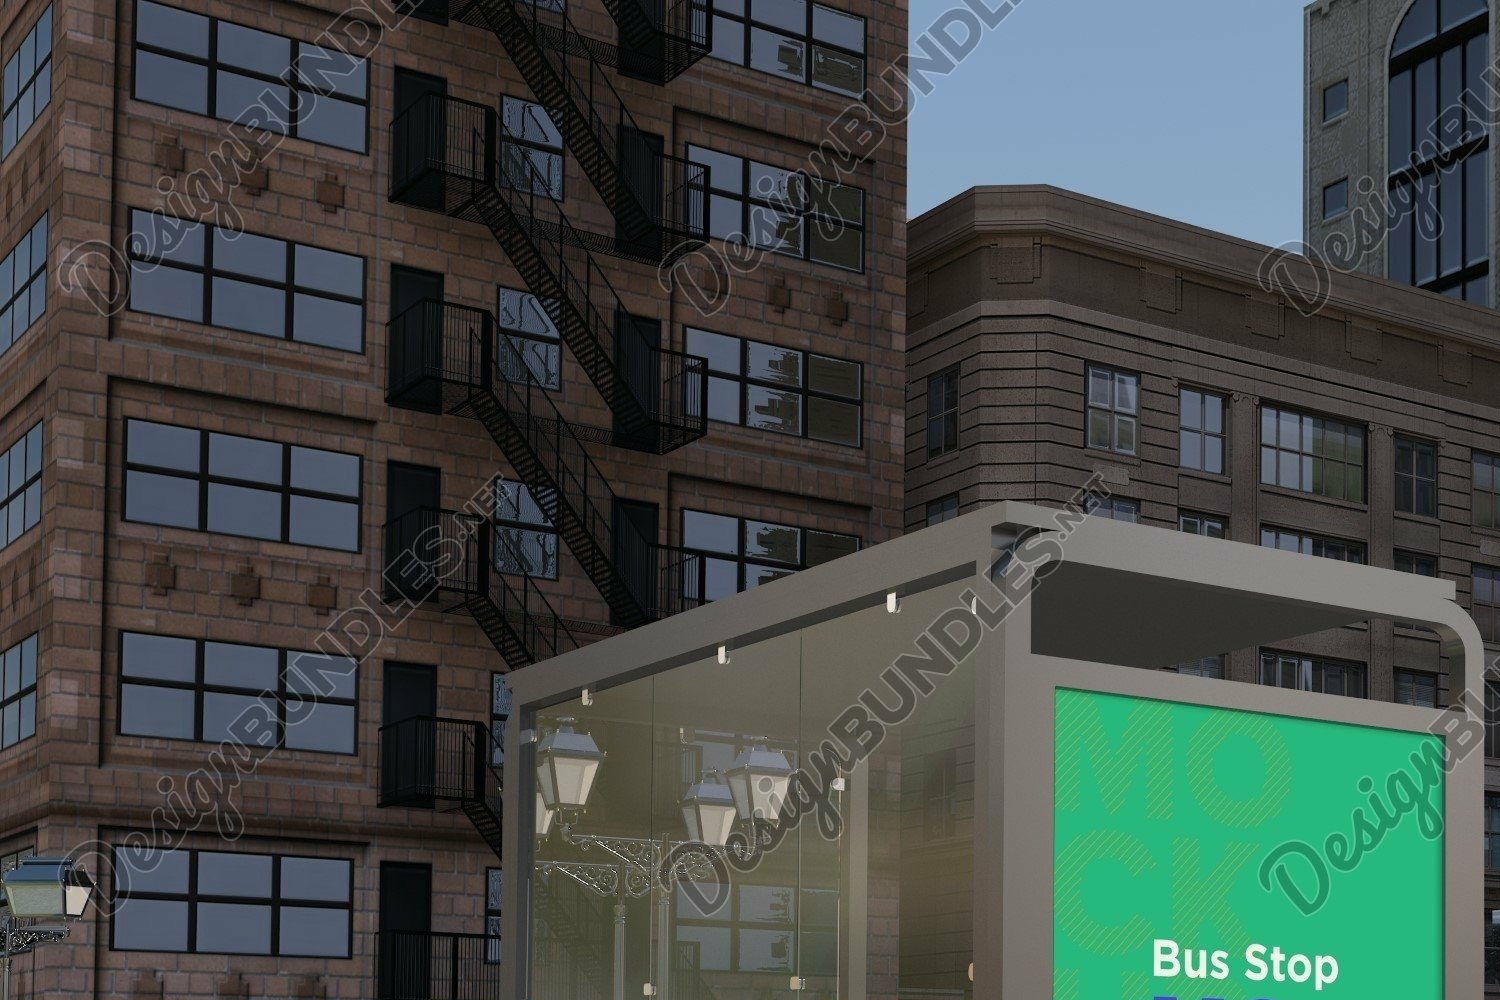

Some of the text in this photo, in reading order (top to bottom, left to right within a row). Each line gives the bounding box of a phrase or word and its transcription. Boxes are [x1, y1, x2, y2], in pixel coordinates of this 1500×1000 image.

[1054, 688, 1293, 829] MO
[1053, 829, 1261, 957] CK
[1153, 938, 1339, 991] Bus Stop
